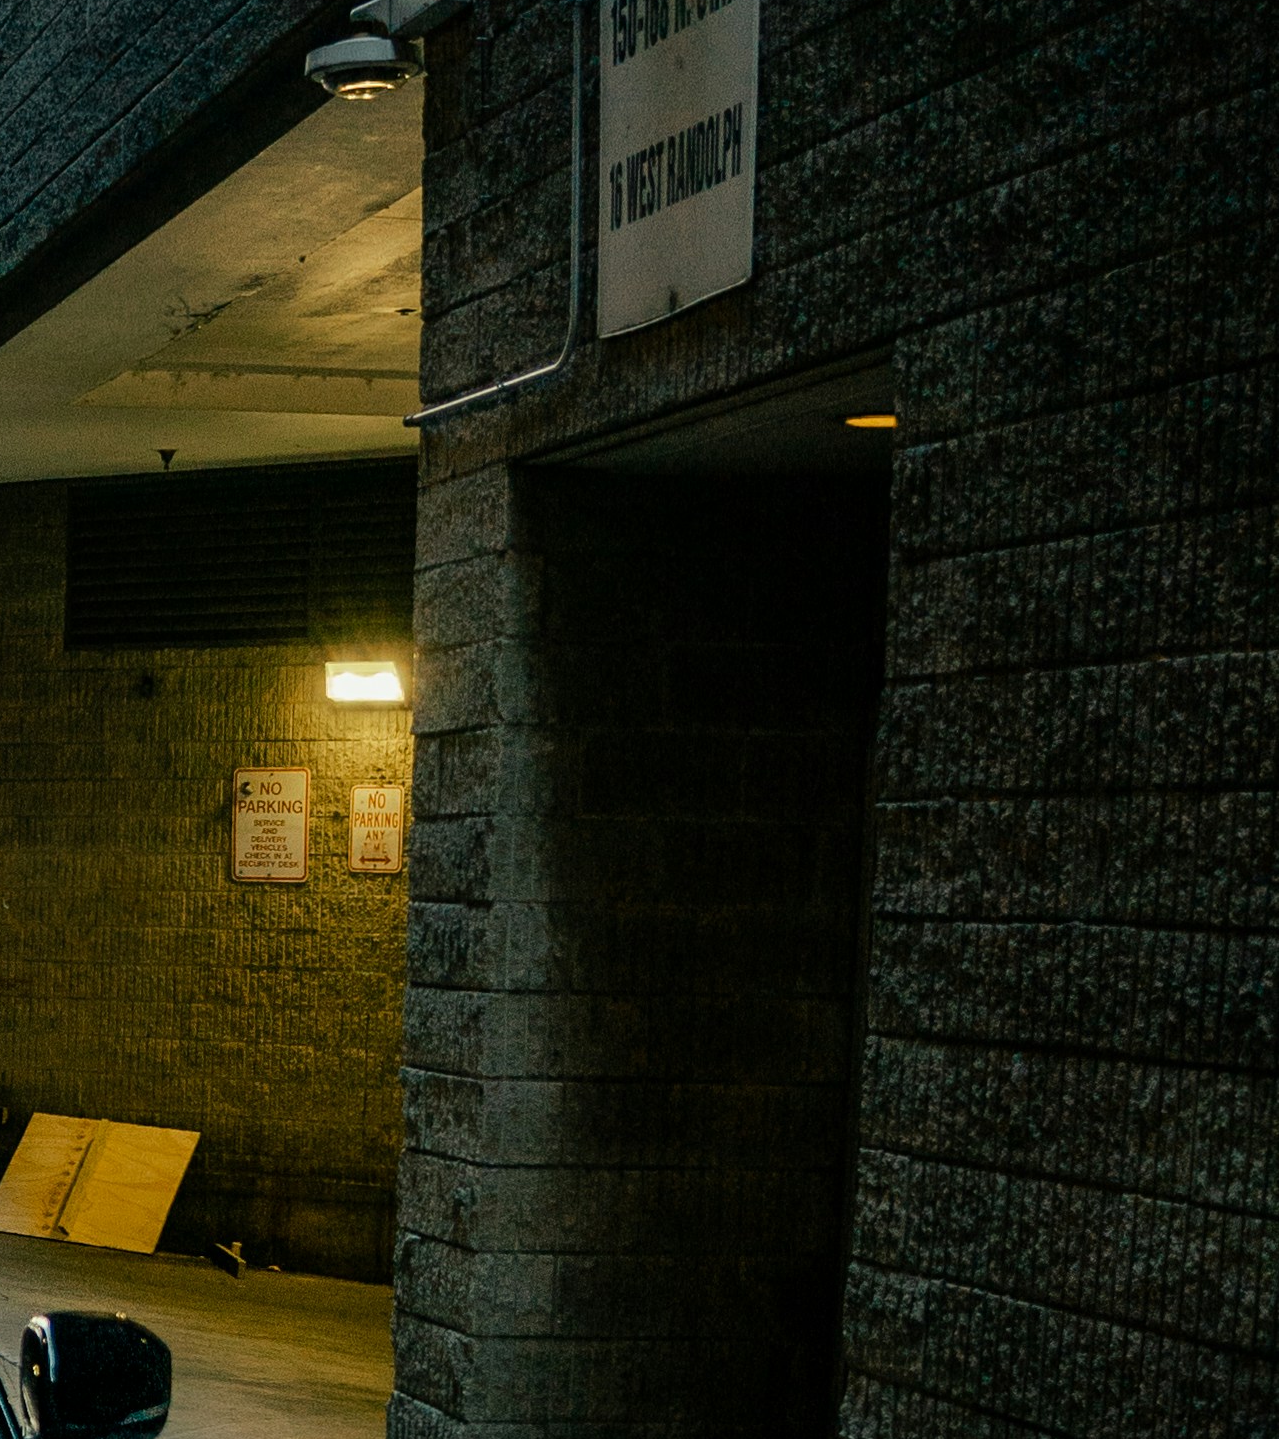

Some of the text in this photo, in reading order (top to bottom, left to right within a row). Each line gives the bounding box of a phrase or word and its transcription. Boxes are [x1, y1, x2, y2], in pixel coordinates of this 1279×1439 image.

[610, 102, 742, 231] 16 WEST RANDOLPH
[259, 782, 282, 795] NO
[238, 800, 303, 813] PARKING
[368, 793, 386, 809] NO
[253, 819, 286, 827] SERVICE
[354, 813, 399, 828] PARKING
[365, 830, 385, 840] ANY
[238, 860, 276, 868] SECURITY
